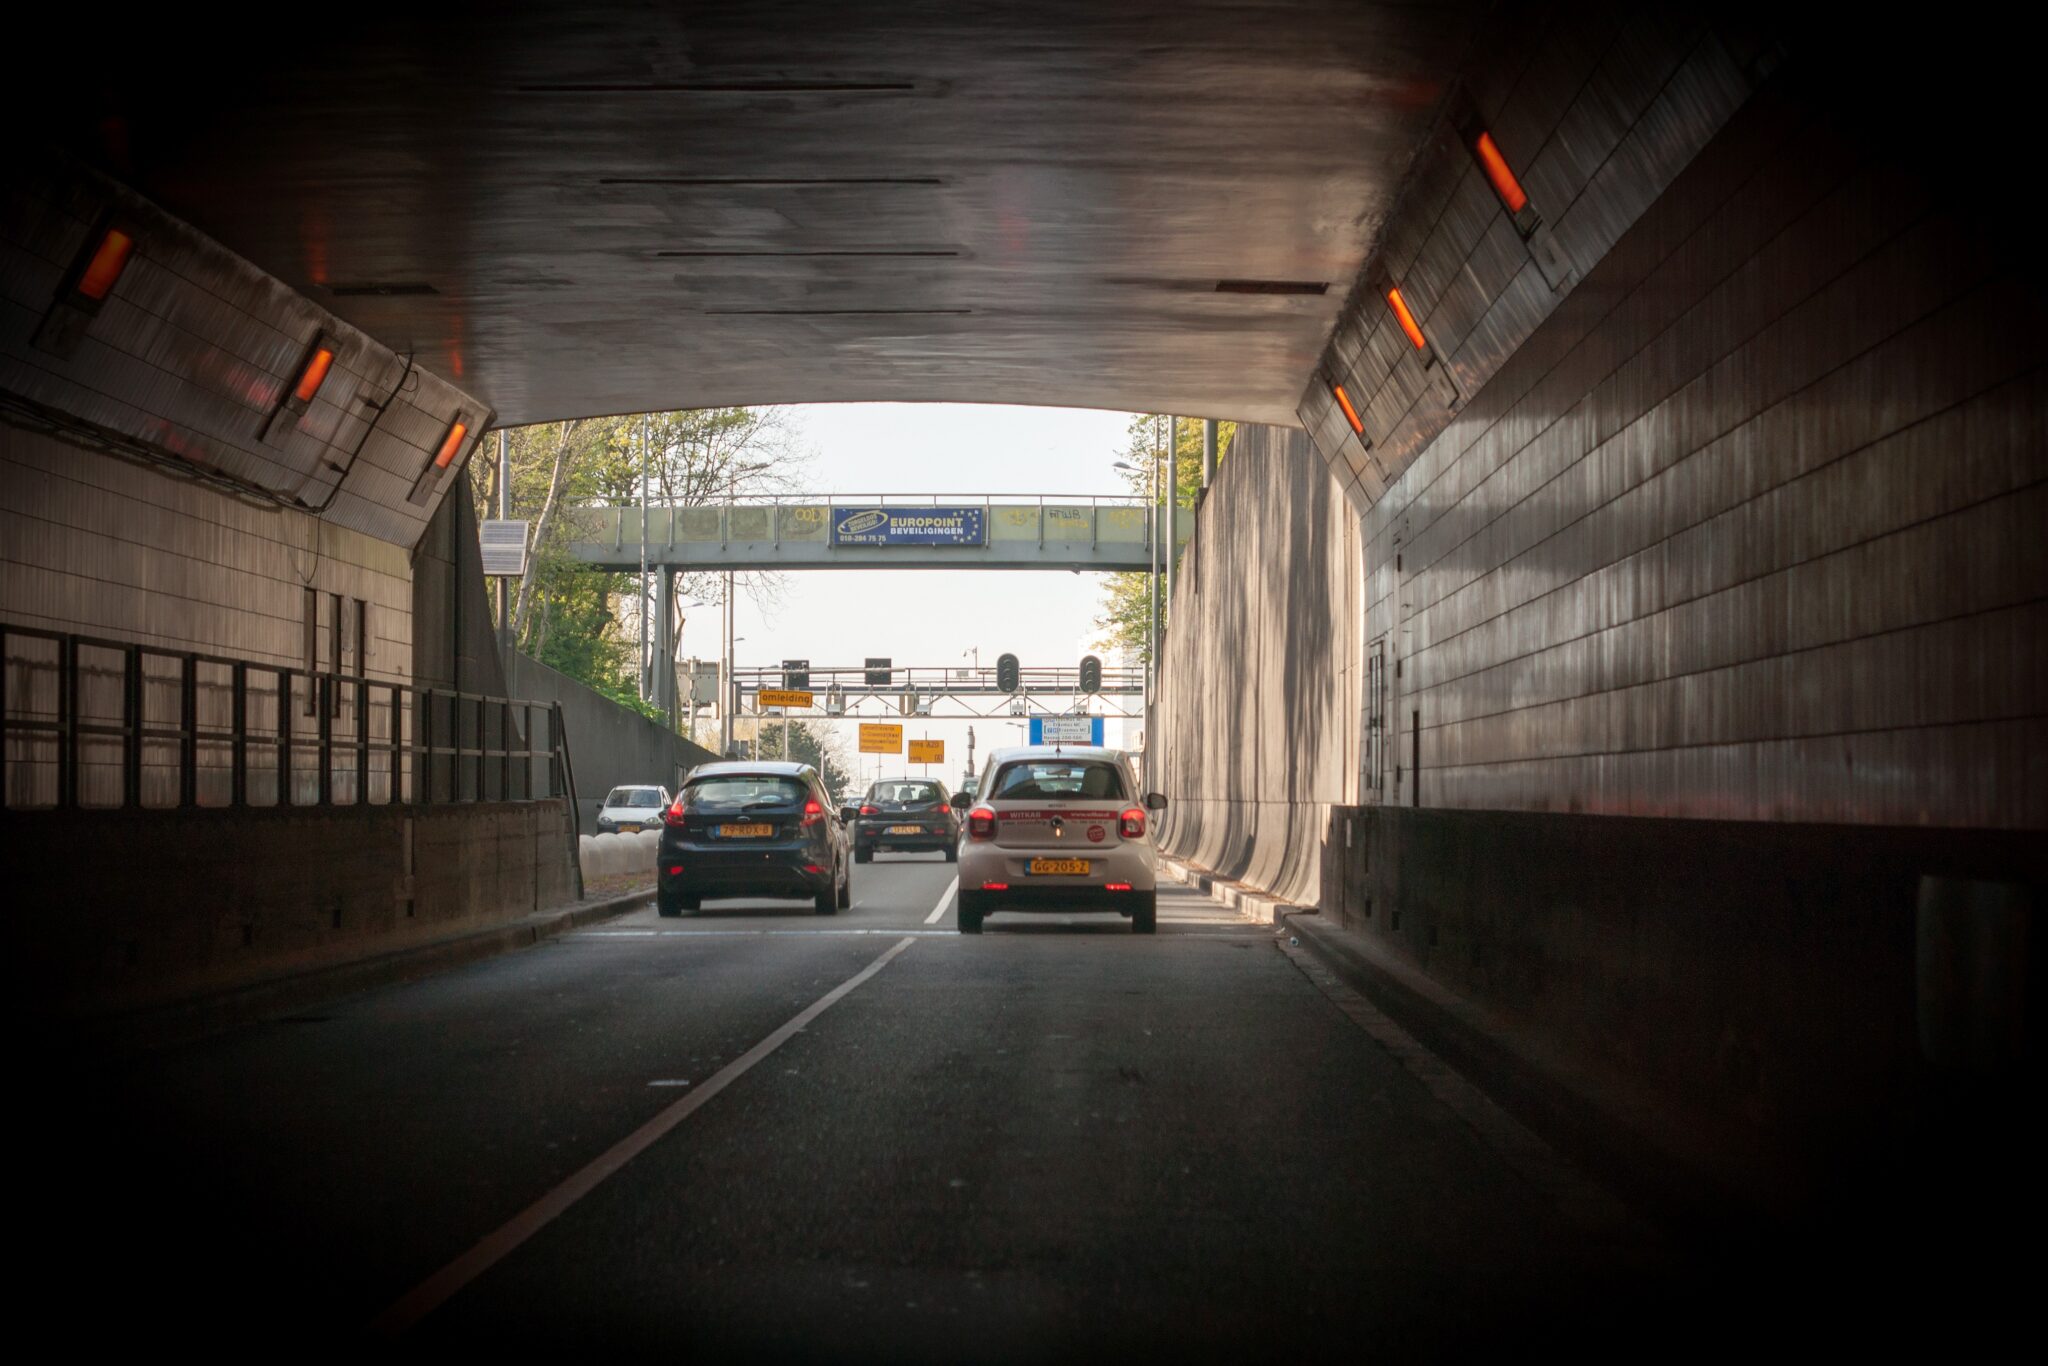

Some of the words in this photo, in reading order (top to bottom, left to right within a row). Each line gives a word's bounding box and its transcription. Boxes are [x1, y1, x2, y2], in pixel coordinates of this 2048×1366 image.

[890, 517, 963, 527] EUROPOINT
[890, 527, 964, 535] BEVEILIGINGEN
[762, 692, 810, 705] omleiding
[1034, 862, 1087, 873] GG-205-Z
